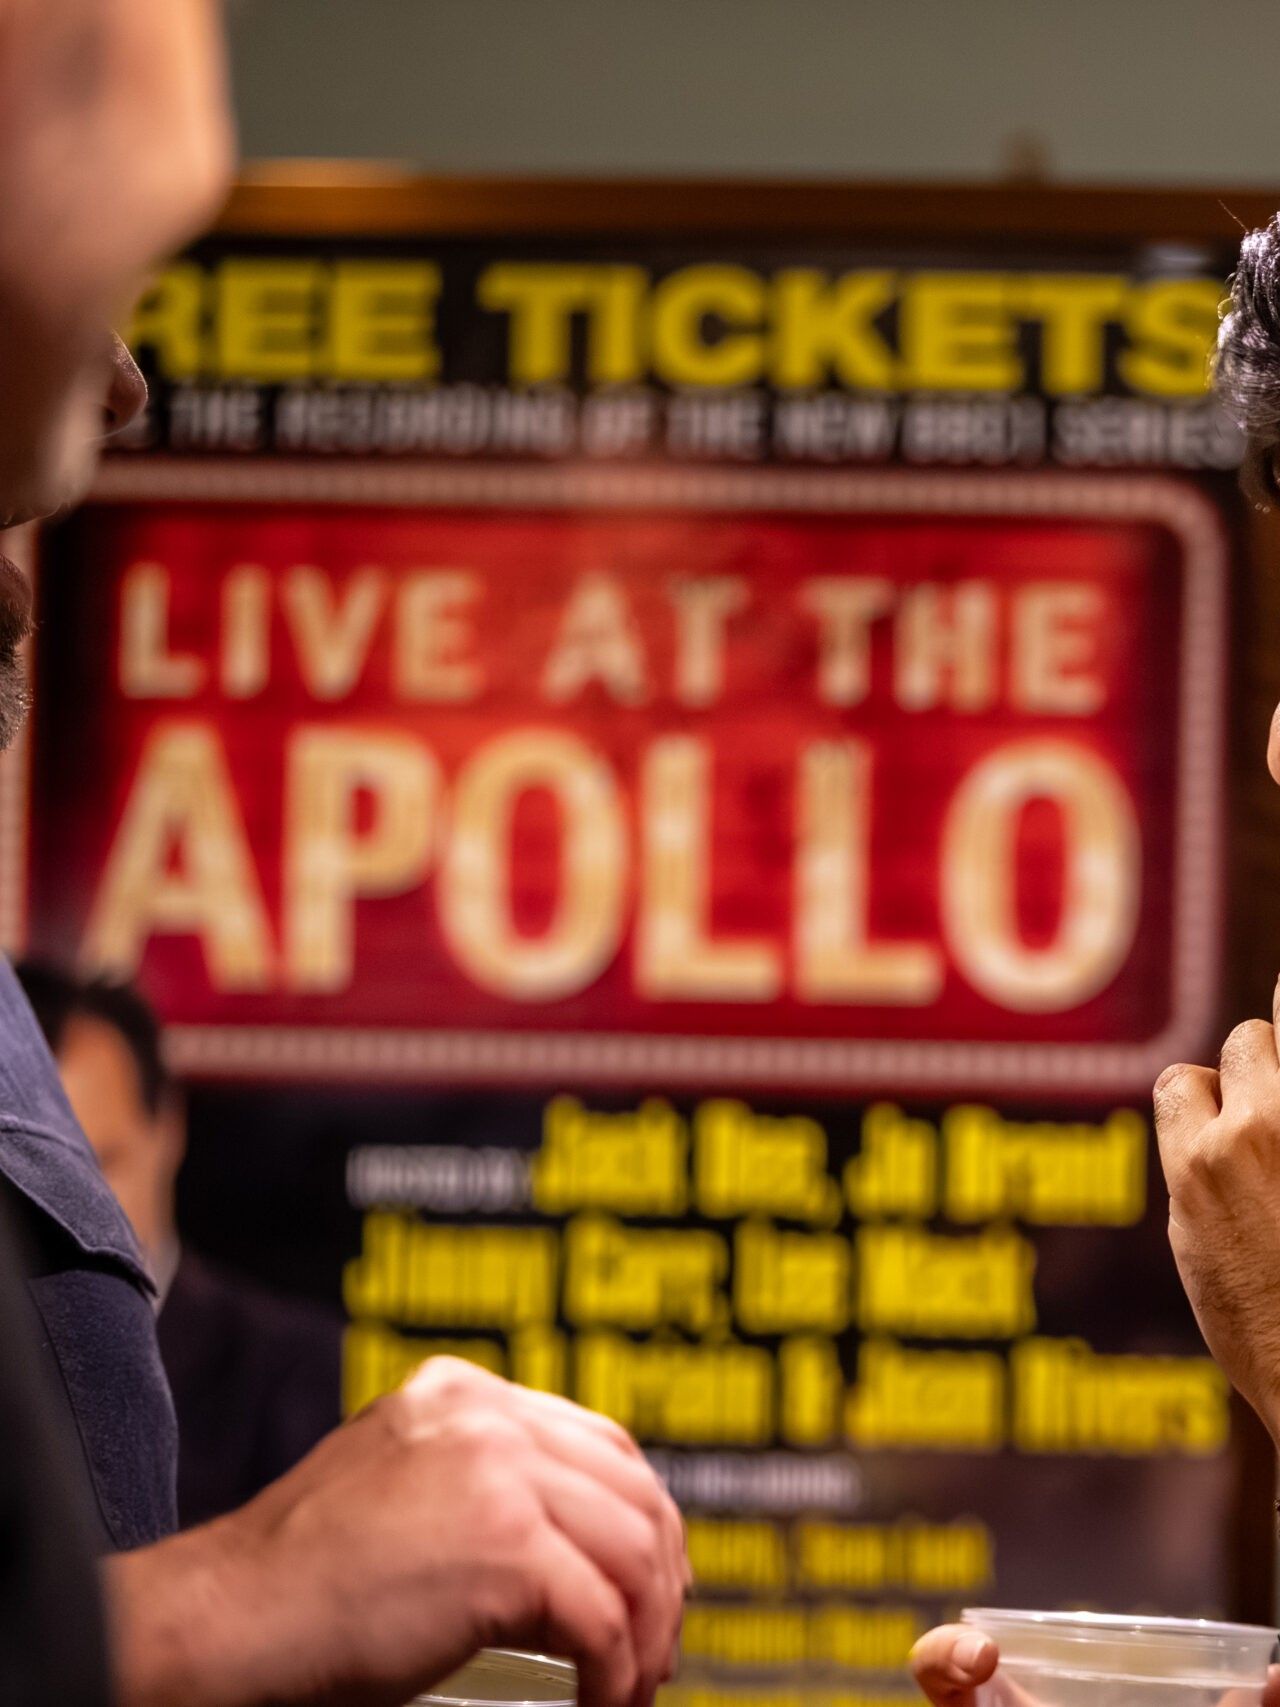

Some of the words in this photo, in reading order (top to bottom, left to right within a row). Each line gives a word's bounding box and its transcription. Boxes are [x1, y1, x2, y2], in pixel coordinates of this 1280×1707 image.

[130, 260, 441, 381] REE
[478, 262, 1226, 395] TICKETS
[118, 560, 485, 703] LIVE
[541, 570, 752, 709] AT
[800, 573, 1109, 717] THE
[75, 720, 1143, 1014] APOLLO
